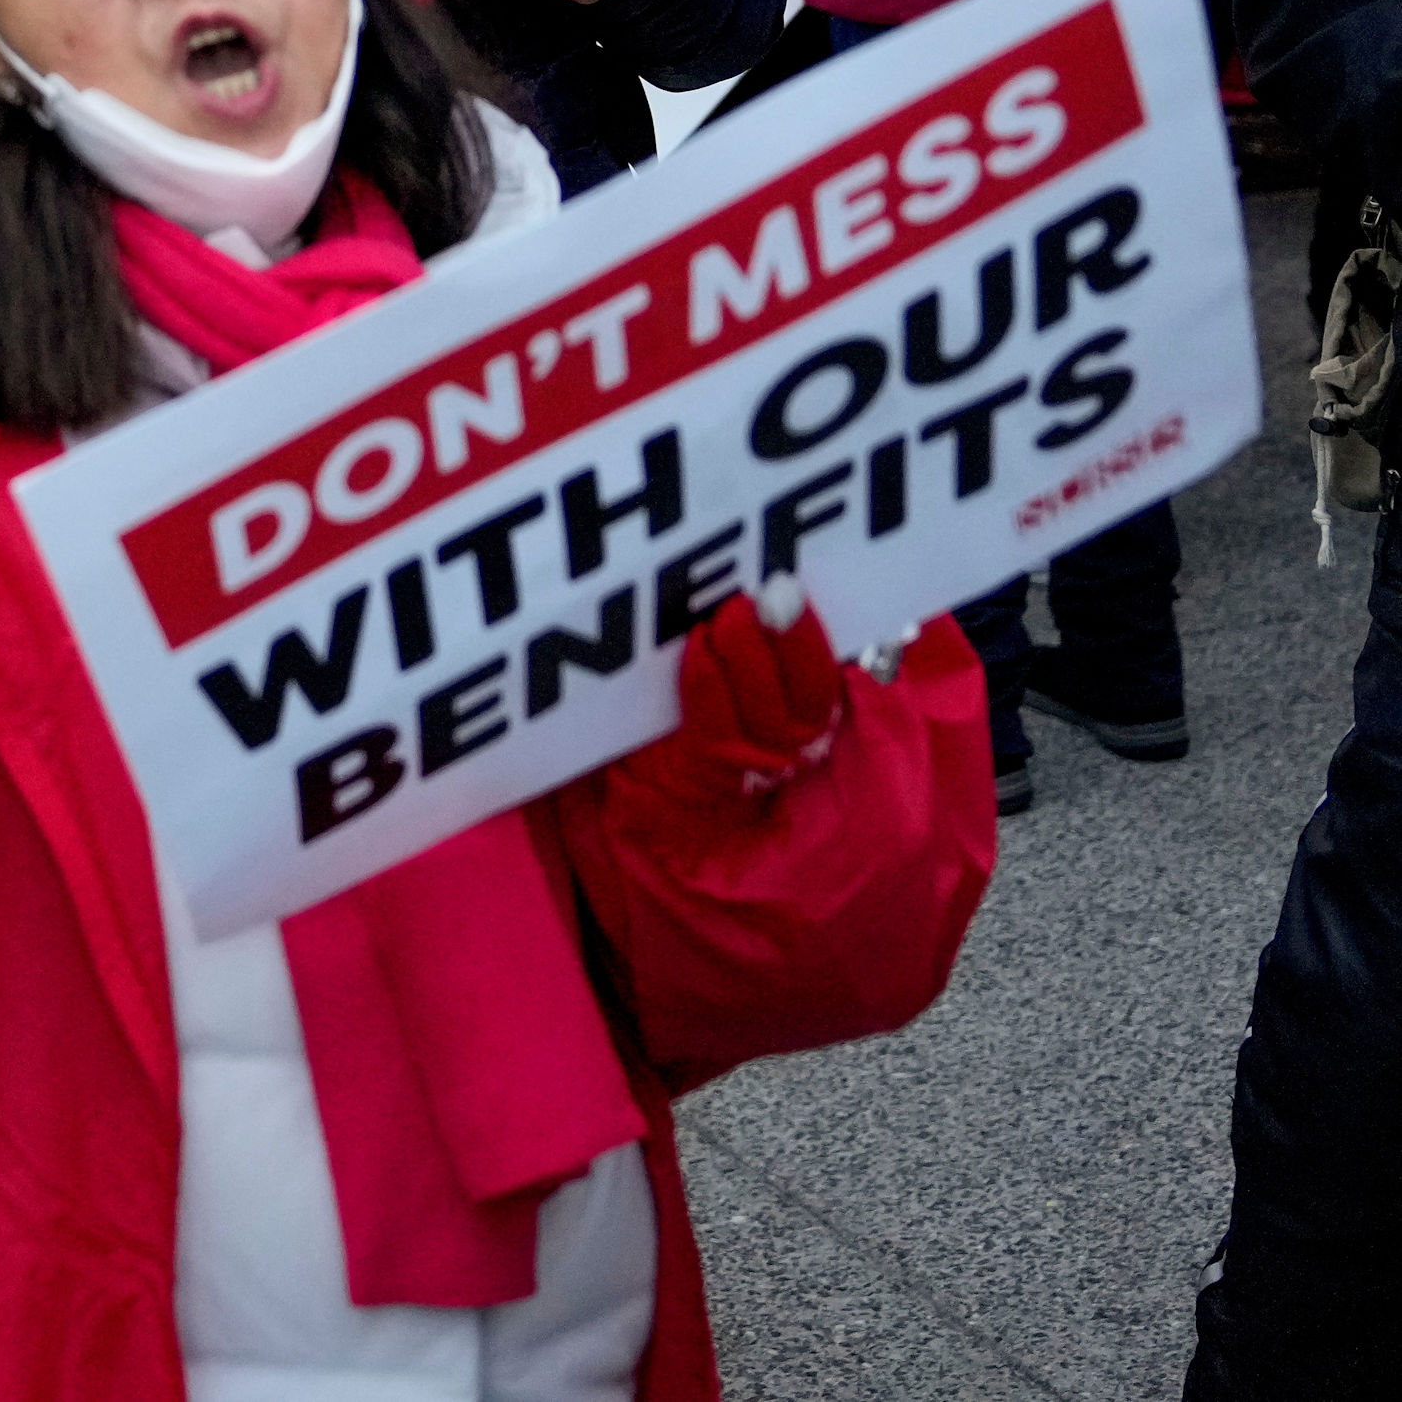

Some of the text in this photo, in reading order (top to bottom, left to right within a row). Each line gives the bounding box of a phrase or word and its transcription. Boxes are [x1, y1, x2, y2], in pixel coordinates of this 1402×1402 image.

[196, 425, 688, 751] WITH
[747, 183, 1152, 462] OUR
[208, 64, 1069, 595] DON'T MESS
[296, 327, 1138, 845] BENEFITS
